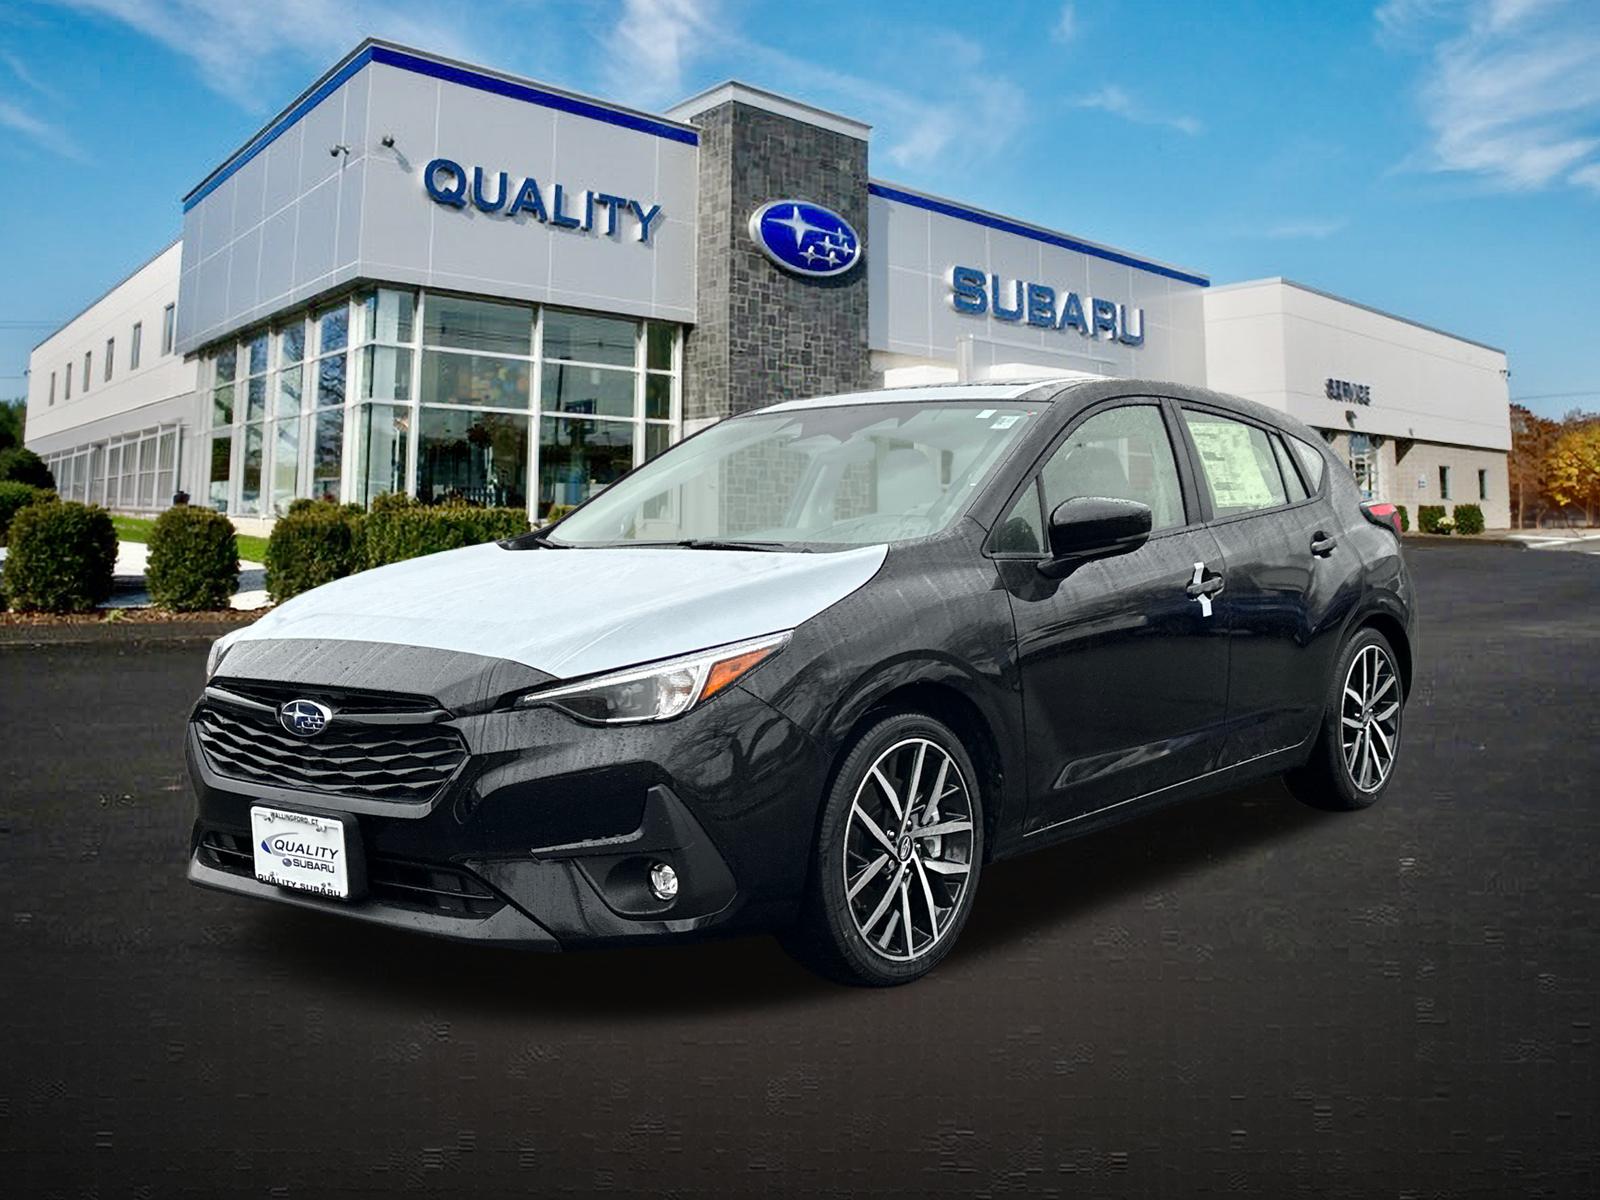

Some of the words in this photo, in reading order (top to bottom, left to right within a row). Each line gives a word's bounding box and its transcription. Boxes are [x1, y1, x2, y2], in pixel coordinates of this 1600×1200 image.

[423, 158, 662, 243] QUALITY
[948, 265, 1145, 347] SUBARU
[1325, 378, 1371, 406] SERVICE
[274, 839, 339, 860] QUALITY
[292, 858, 335, 874] SUBARU
[257, 873, 297, 888] QUALITY
[299, 882, 342, 898] SUBARU
